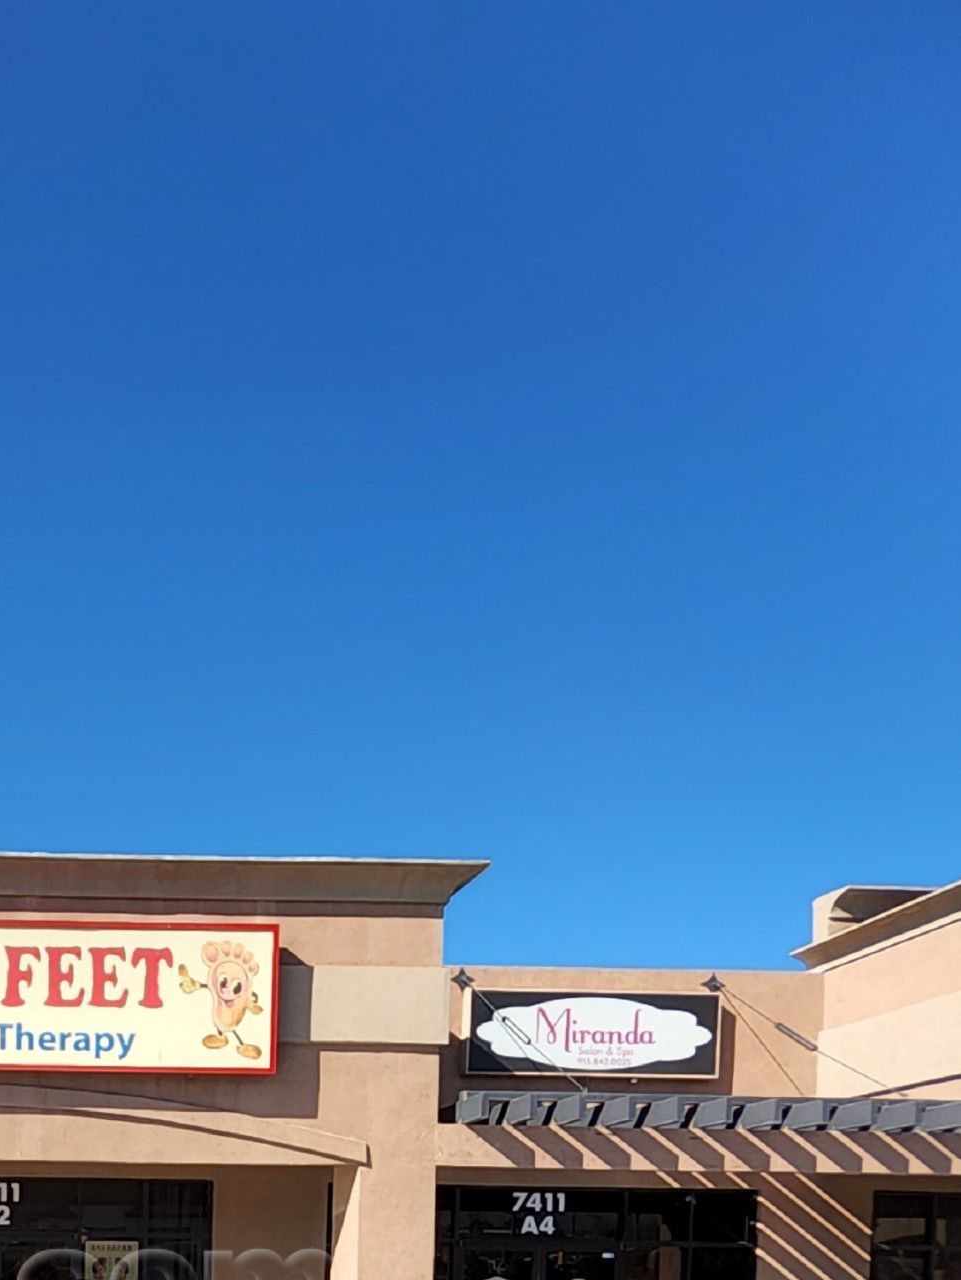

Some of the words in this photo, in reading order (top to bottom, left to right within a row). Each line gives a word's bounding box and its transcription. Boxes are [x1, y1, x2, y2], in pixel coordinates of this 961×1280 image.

[1, 946, 173, 1009] FEET
[536, 1006, 656, 1053] Miranda
[578, 1046, 603, 1055] Salon
[606, 1046, 614, 1055] &
[616, 1046, 634, 1057] Spa
[512, 1192, 566, 1212] 7411
[521, 1215, 556, 1235] A4
